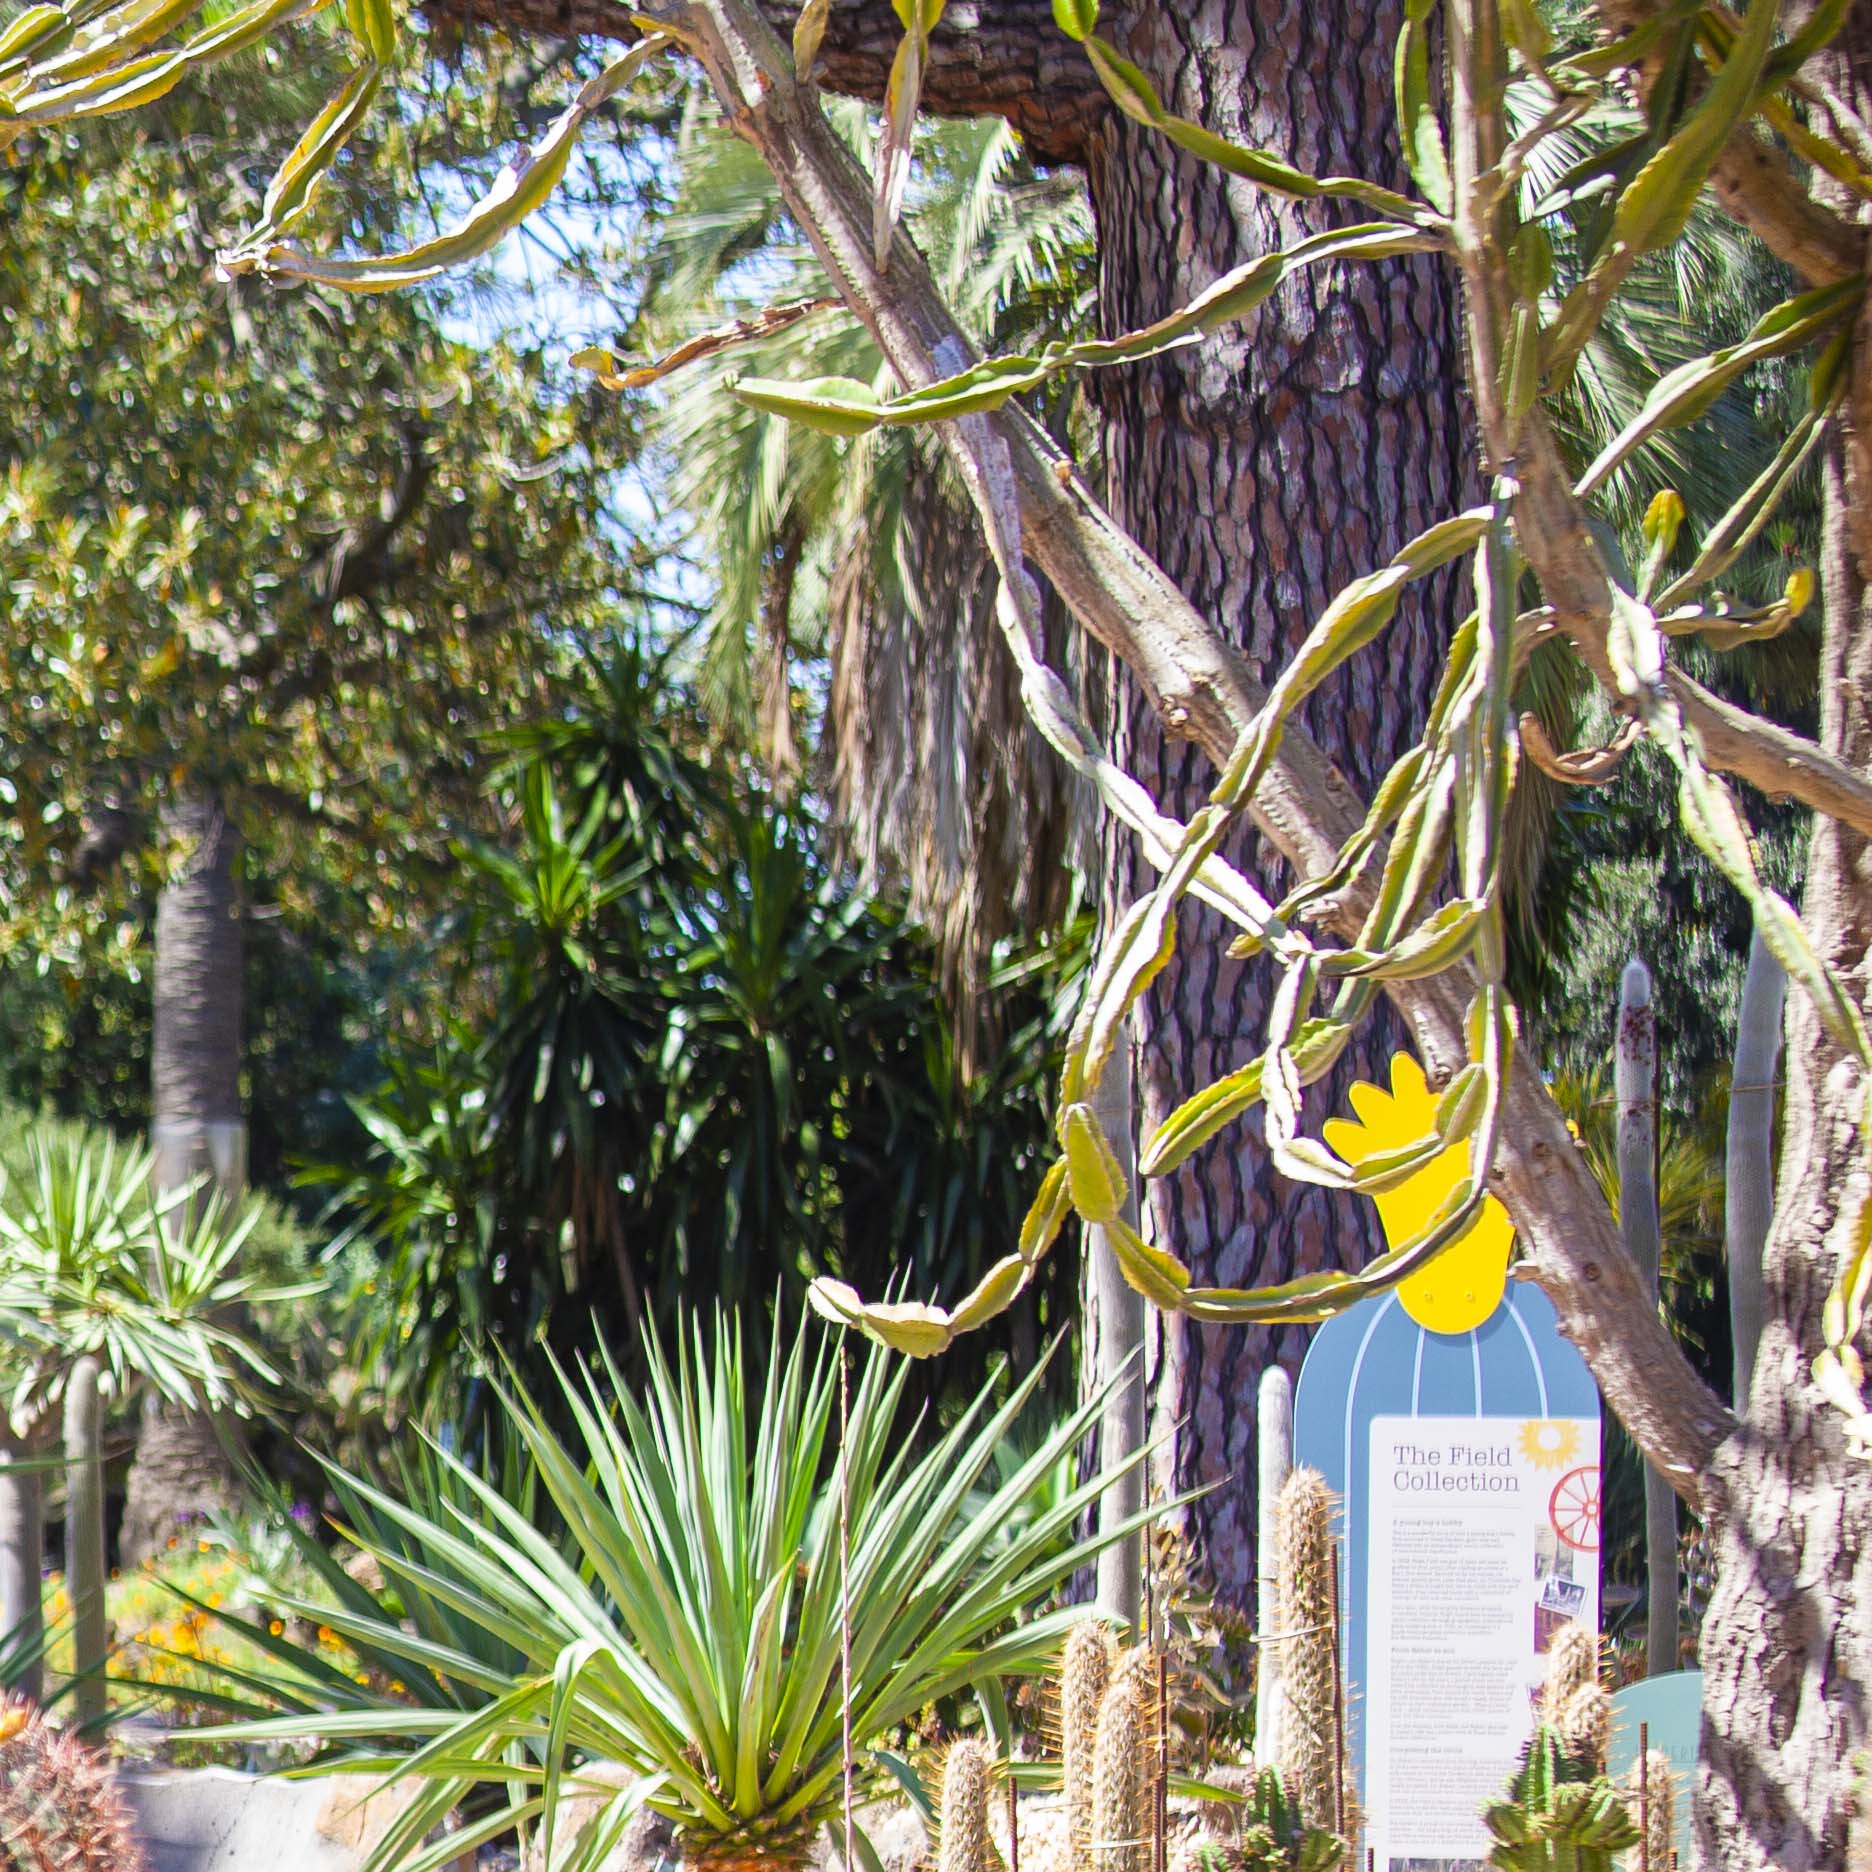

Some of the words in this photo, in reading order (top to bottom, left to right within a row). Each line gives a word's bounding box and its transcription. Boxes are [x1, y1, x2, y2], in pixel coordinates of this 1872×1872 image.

[1393, 1445, 1441, 1466] The
[1448, 1445, 1513, 1467] Field
[1393, 1470, 1521, 1493] Collection
